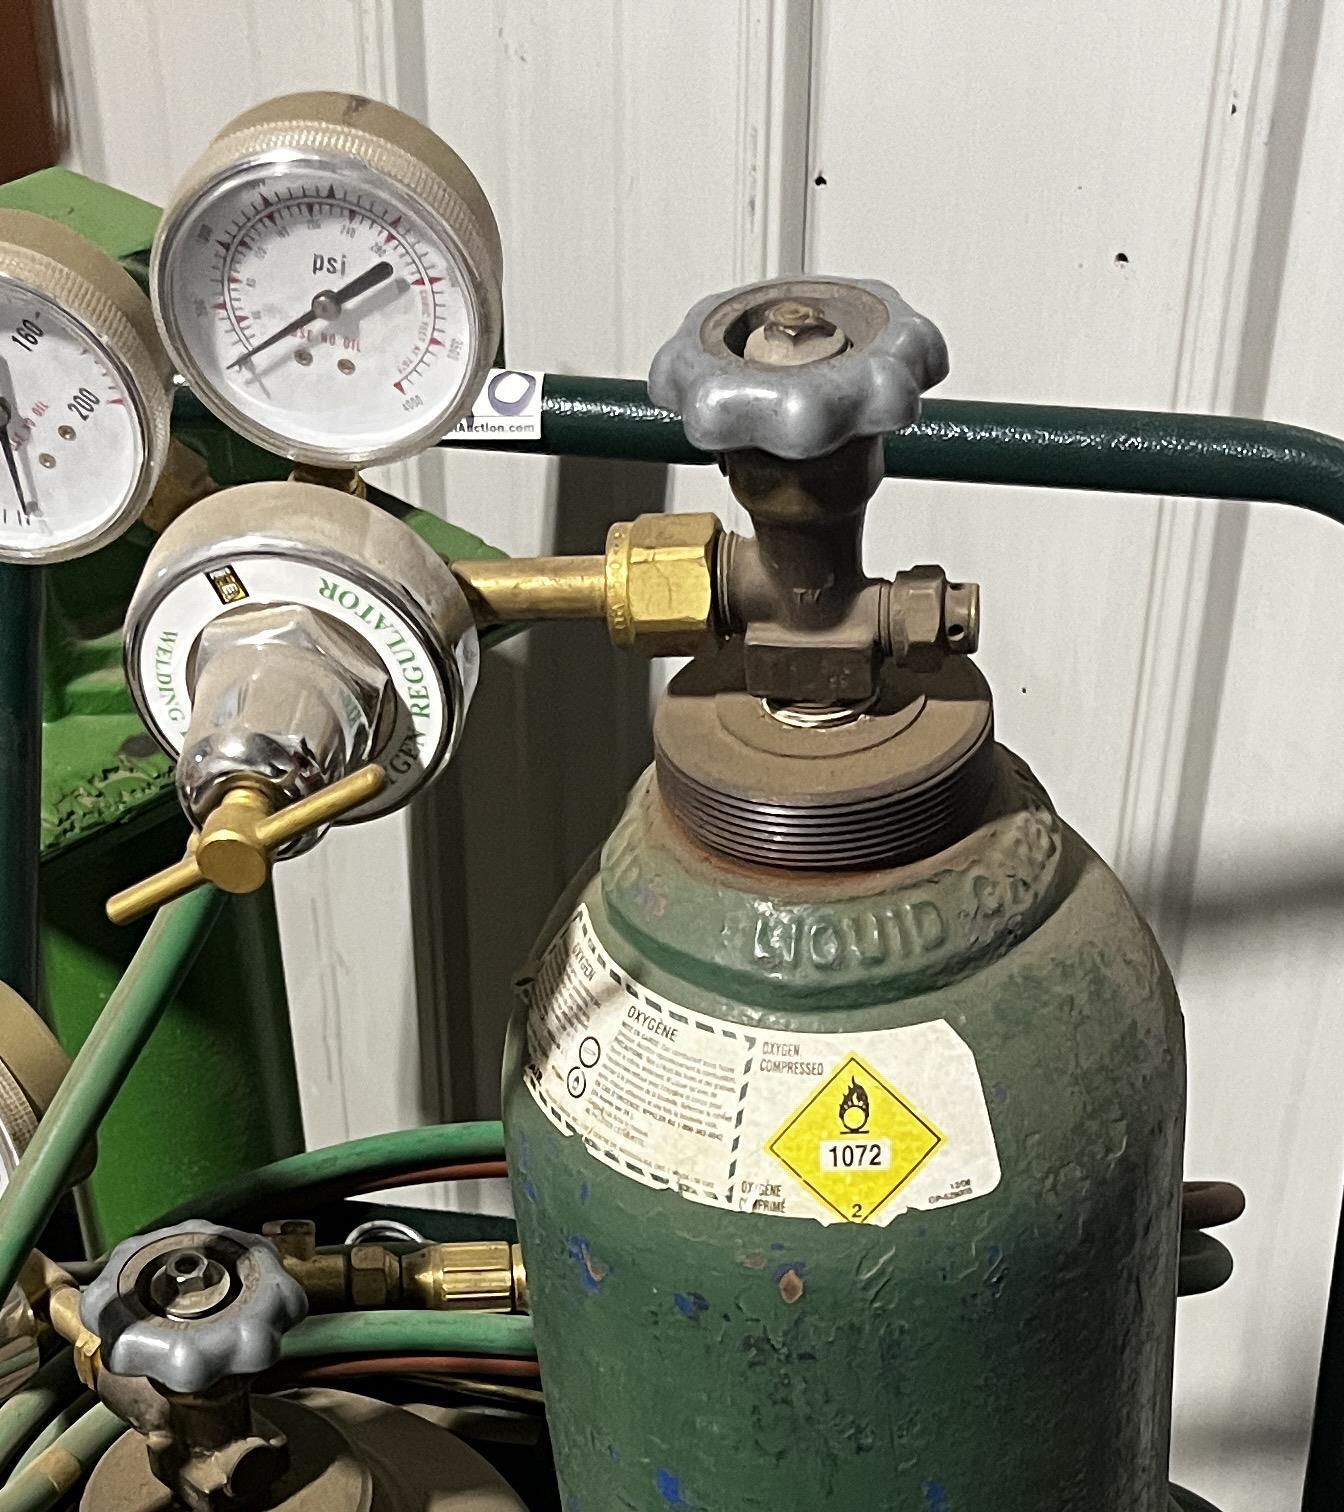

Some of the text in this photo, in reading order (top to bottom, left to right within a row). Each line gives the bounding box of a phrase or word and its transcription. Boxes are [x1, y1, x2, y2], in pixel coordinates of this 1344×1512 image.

[312, 252, 347, 278] psi
[11, 318, 45, 352] 160
[67, 387, 101, 422] 200
[318, 576, 432, 720] REGULATOR
[155, 630, 186, 722] WELDING
[626, 1004, 680, 1043] OXYGÈNE
[759, 1058, 825, 1076] COMPRESSED
[828, 1143, 883, 1168] 1072
[850, 1202, 864, 1219] 2
